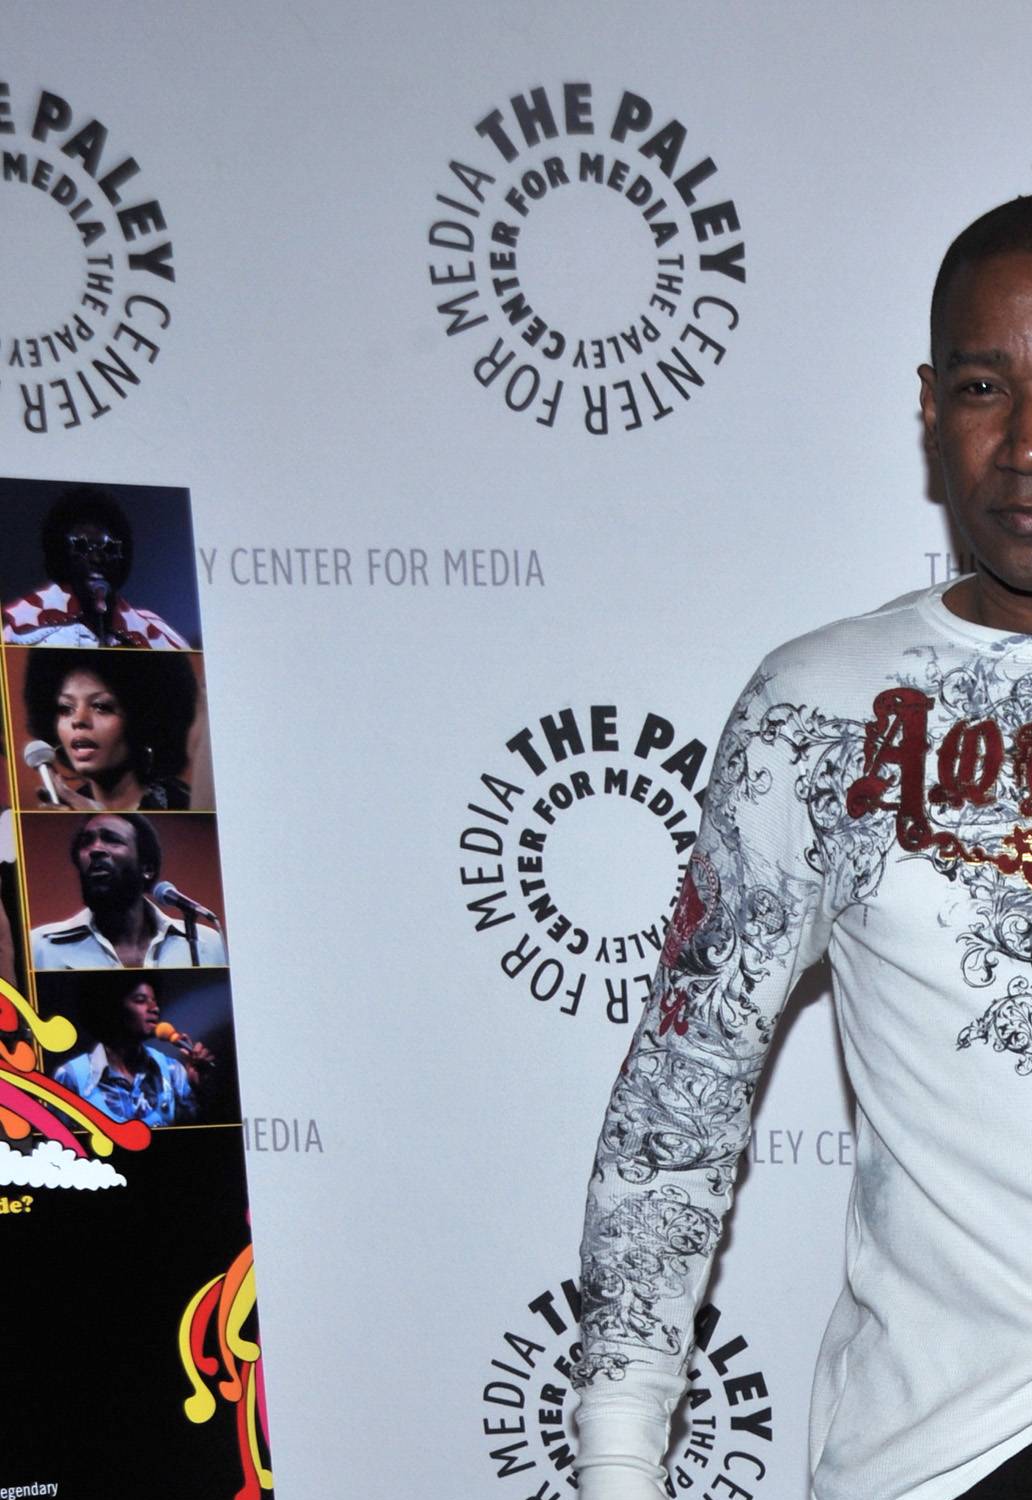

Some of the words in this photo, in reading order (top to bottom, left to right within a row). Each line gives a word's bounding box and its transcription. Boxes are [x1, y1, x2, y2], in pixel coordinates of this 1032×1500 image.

[475, 83, 594, 163] THE
[2, 150, 106, 247] MEDIA
[31, 90, 175, 282] PALEY
[505, 156, 570, 217] FOR
[579, 152, 679, 248] MEDIA
[610, 91, 746, 283] PALEY
[82, 254, 113, 316] THE
[428, 160, 496, 336] MEDIA
[489, 221, 565, 360] CENTER
[649, 254, 684, 317] THE
[9, 313, 94, 367] PALEY
[20, 295, 170, 433] CENTER
[474, 337, 563, 427] FOR
[573, 315, 661, 369] PALEY
[583, 296, 739, 435] CENTER
[231, 548, 352, 586] CENTER
[368, 548, 429, 587] FOR
[444, 549, 545, 587] MEDIA
[506, 705, 619, 776] THE
[533, 771, 595, 825] FOR
[604, 767, 697, 854] MEDIA
[460, 773, 525, 932] MEDIA
[517, 828, 589, 954] CENTER
[501, 933, 586, 1016] FOR
[752, 1129, 803, 1165] LEY
[483, 1332, 546, 1478] MEDIA
[694, 1303, 772, 1441] ALEY
[538, 1383, 578, 1488] NTER
[684, 1416, 716, 1468] THE
[0, 1481, 58, 1500] egendary
